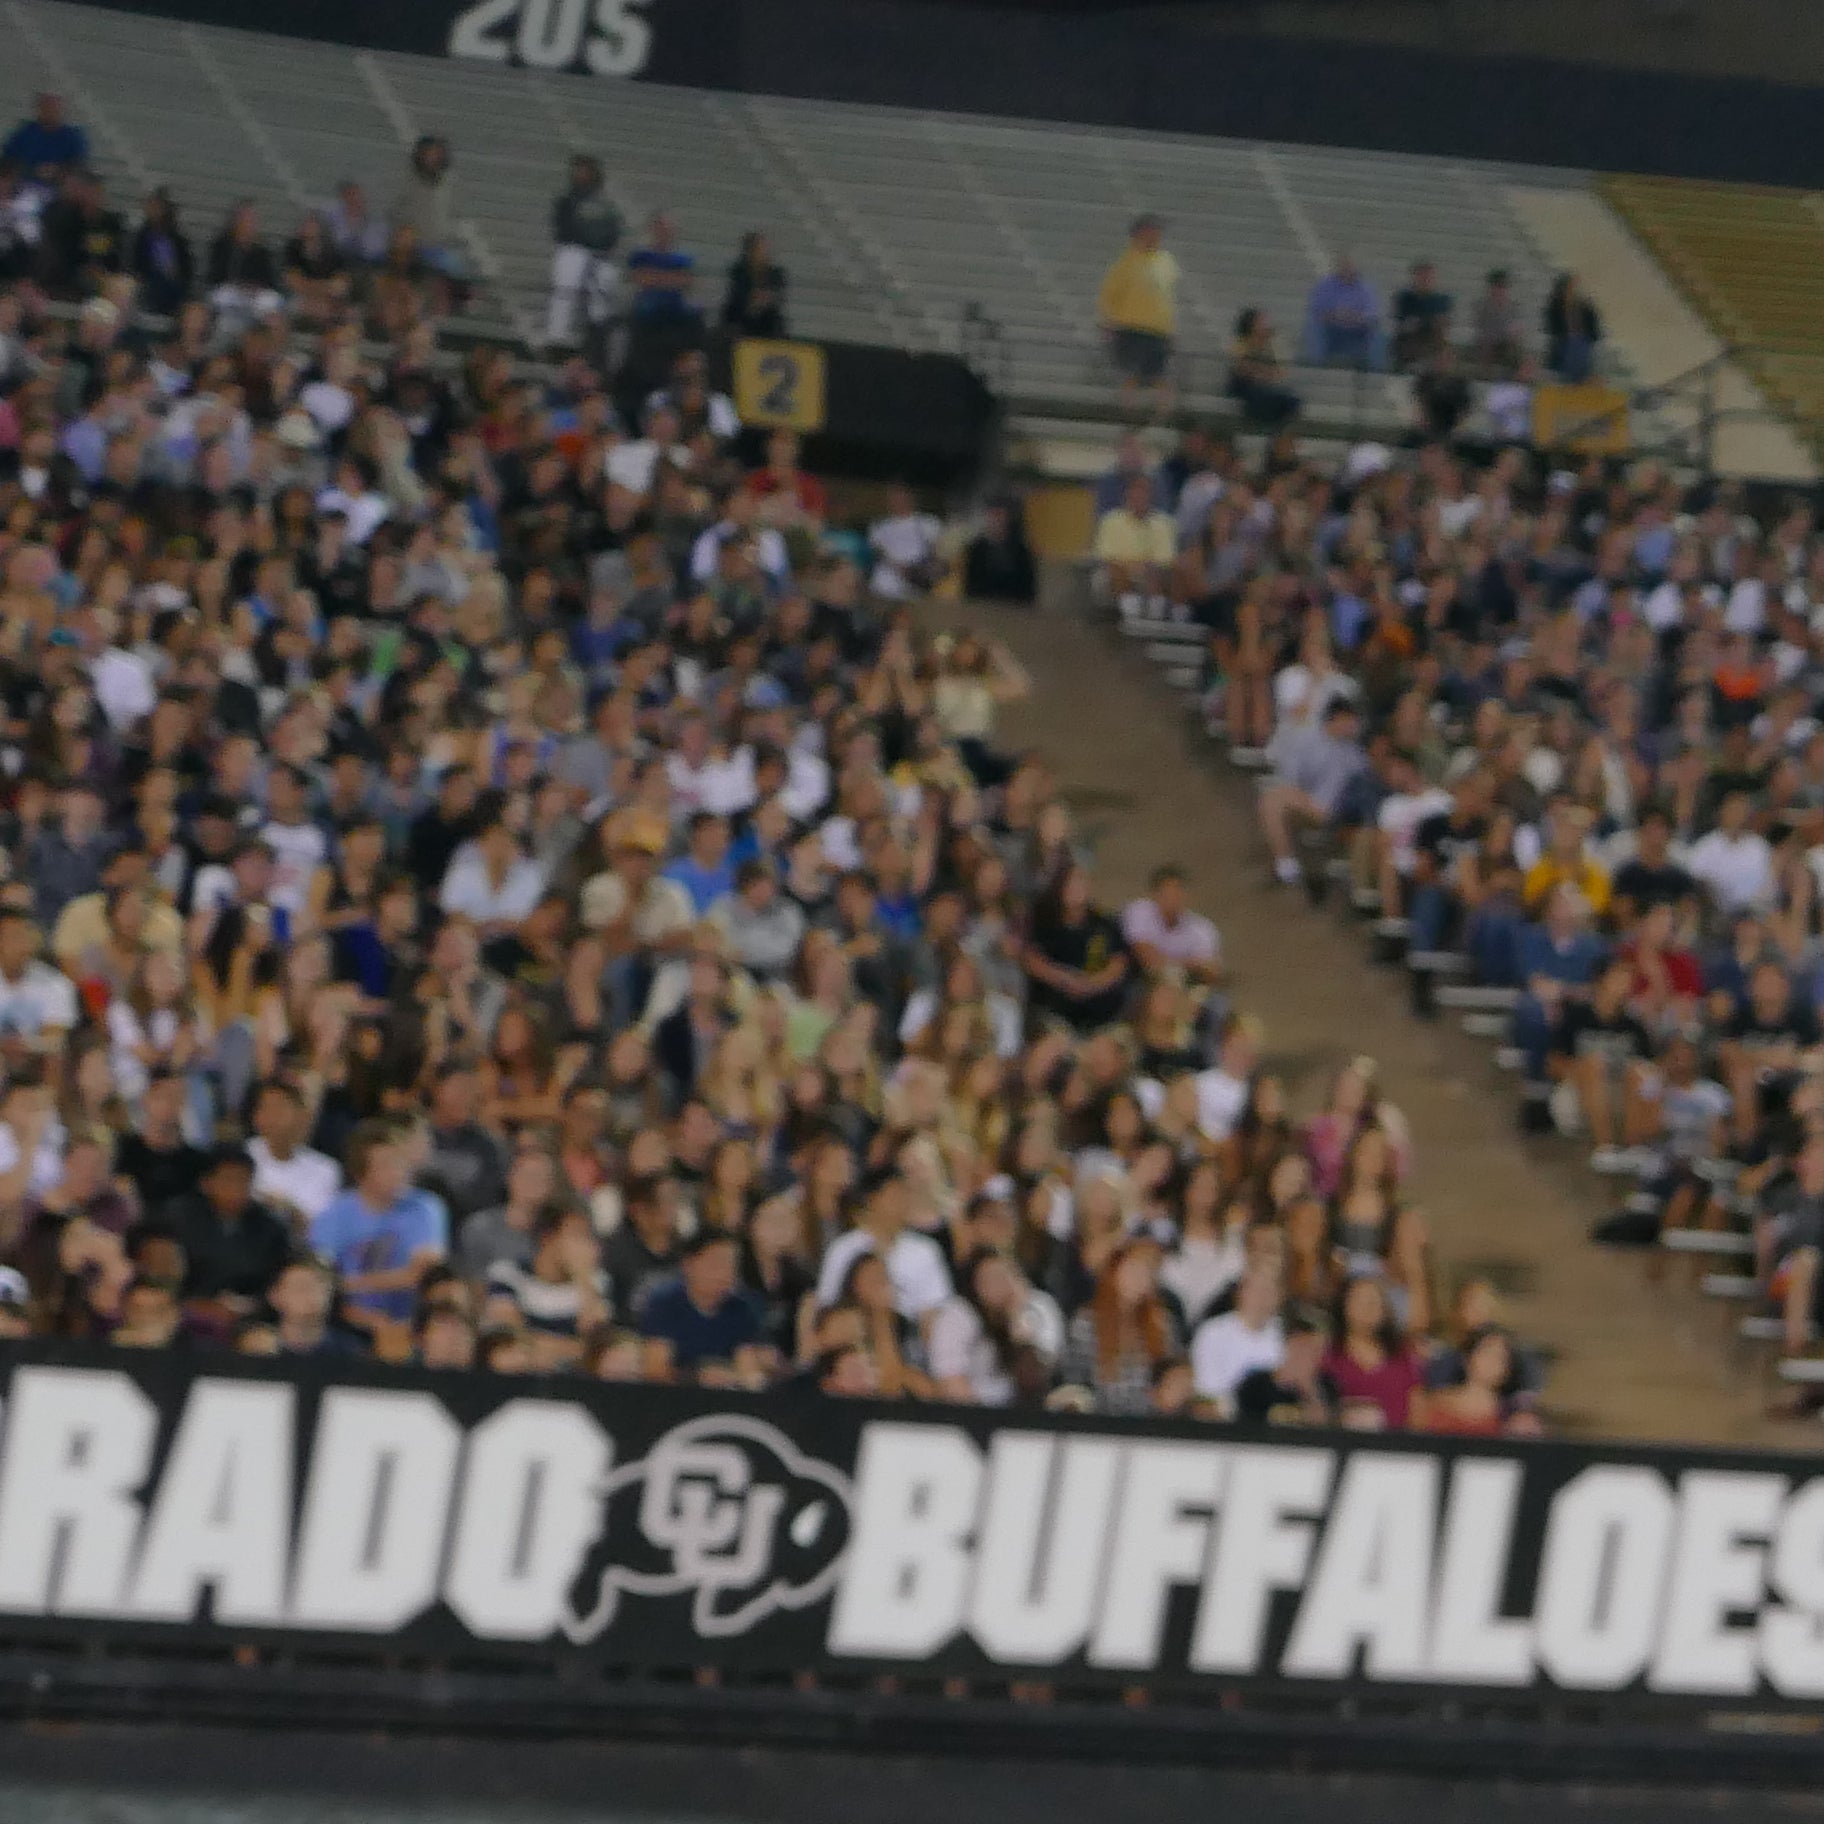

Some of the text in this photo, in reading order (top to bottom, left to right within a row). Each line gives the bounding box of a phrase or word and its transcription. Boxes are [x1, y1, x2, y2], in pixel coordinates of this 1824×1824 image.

[449, 0, 652, 76] 205
[755, 353, 799, 416] 2
[0, 1364, 614, 1642] RADO
